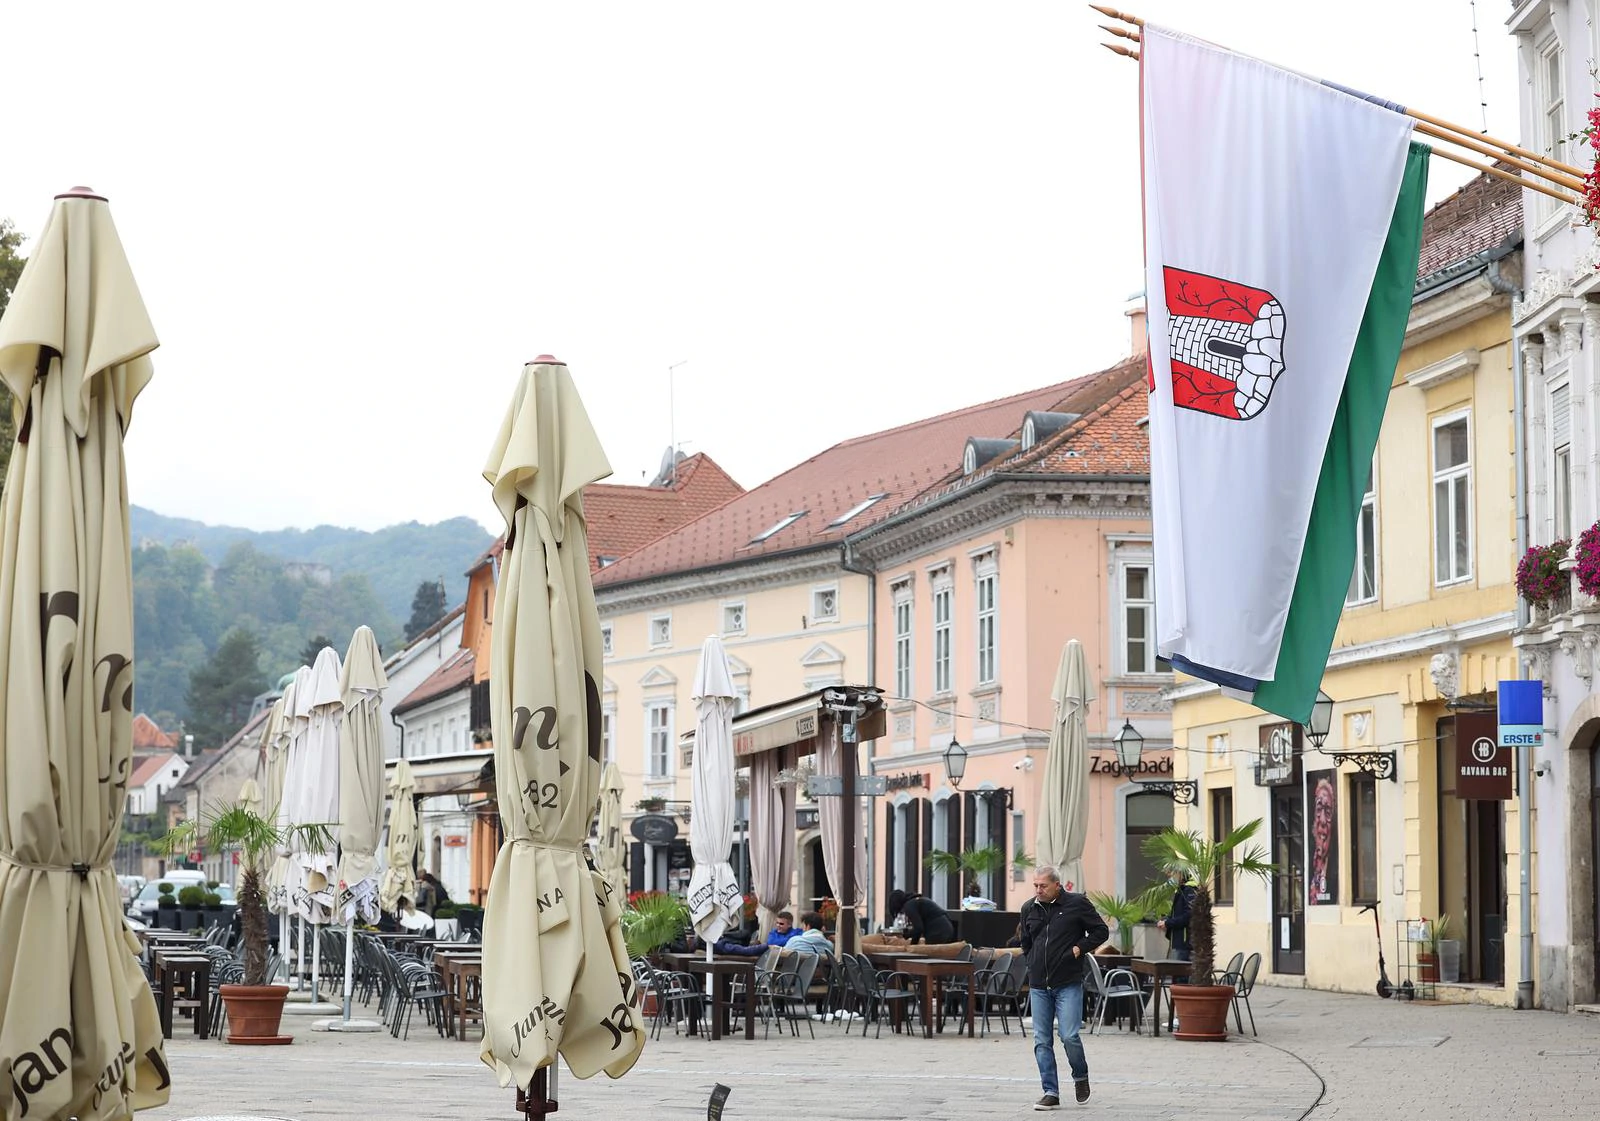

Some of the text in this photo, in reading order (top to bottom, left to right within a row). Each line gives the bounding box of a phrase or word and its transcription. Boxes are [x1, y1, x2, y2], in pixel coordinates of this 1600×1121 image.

[1503, 735, 1533, 744] ERSTE
[1090, 756, 1174, 778] Zagbačk
[1461, 766, 1507, 776] HAVANA BAR
